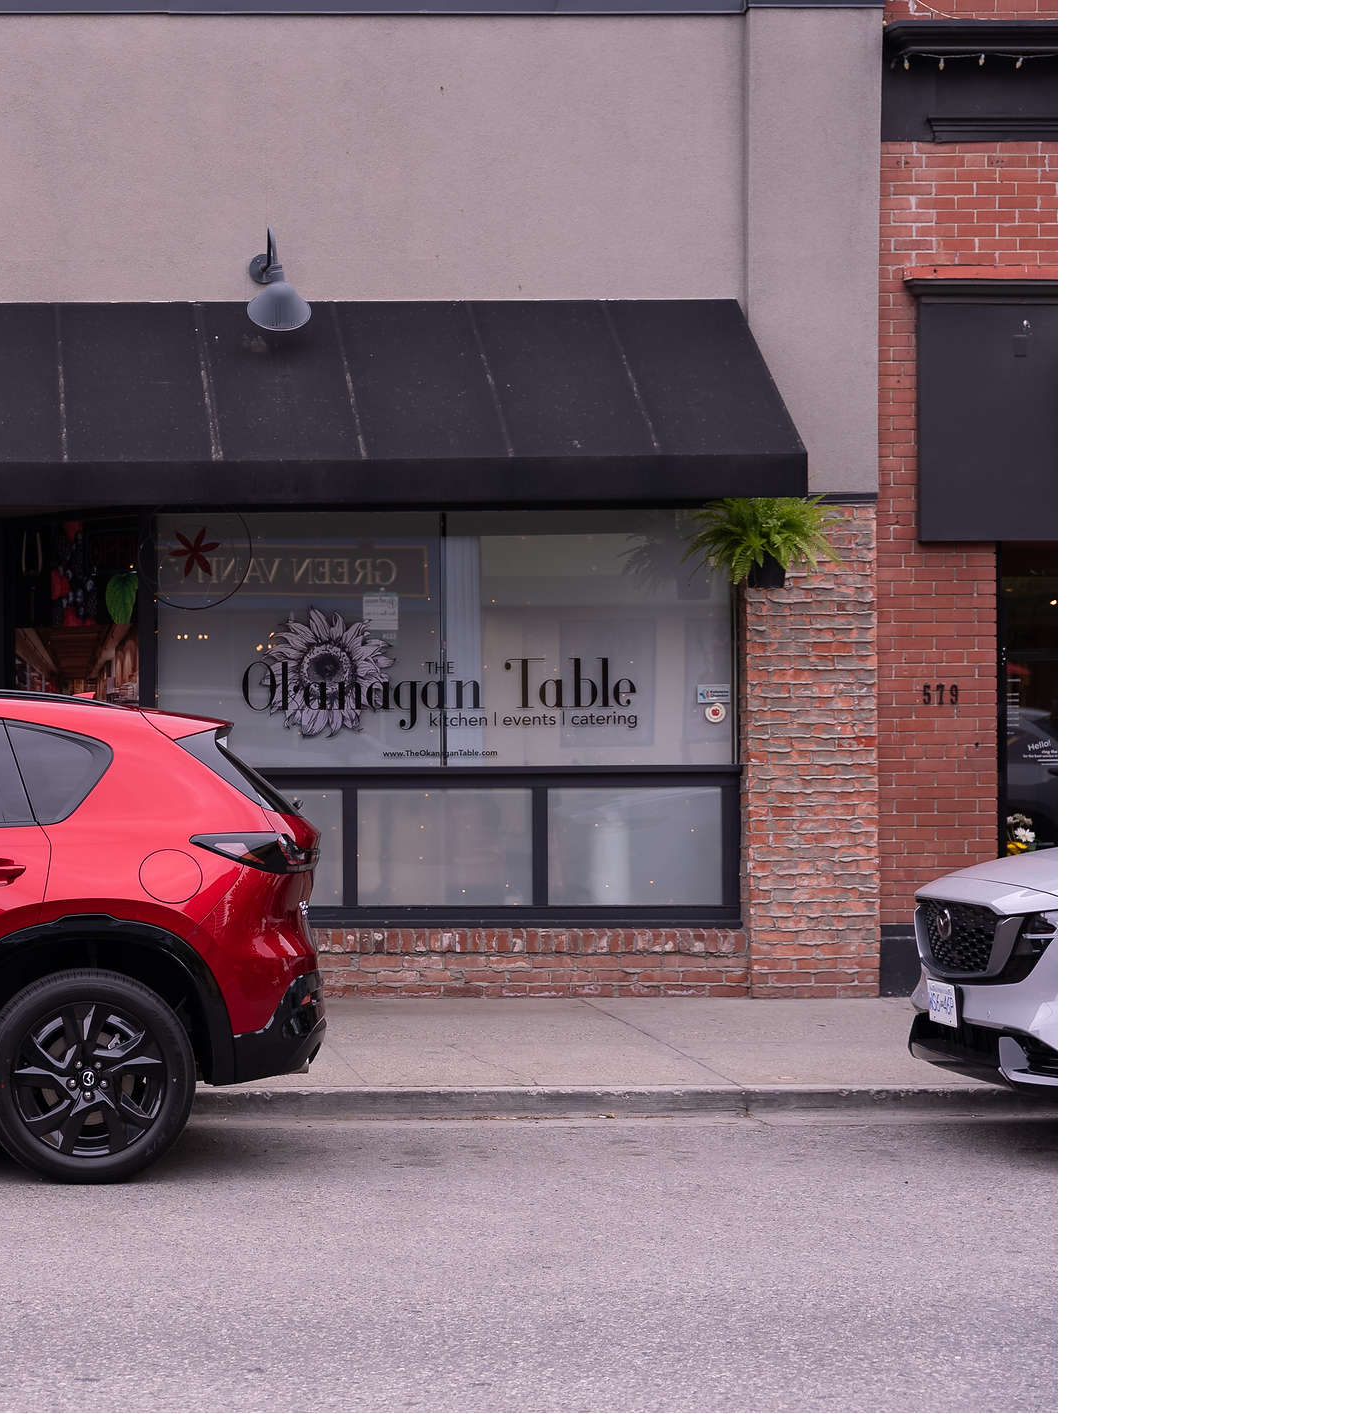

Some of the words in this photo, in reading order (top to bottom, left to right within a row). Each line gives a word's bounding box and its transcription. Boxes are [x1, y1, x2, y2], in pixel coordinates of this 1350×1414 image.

[425, 661, 455, 675] THE
[242, 661, 485, 731] Okanagan
[504, 657, 637, 709] Table
[923, 683, 958, 705] 579
[429, 712, 488, 727] kitchen
[503, 713, 556, 727] events
[571, 712, 638, 729] catering
[1028, 740, 1051, 751] Hello!
[144, 1131, 167, 1157] H/T
